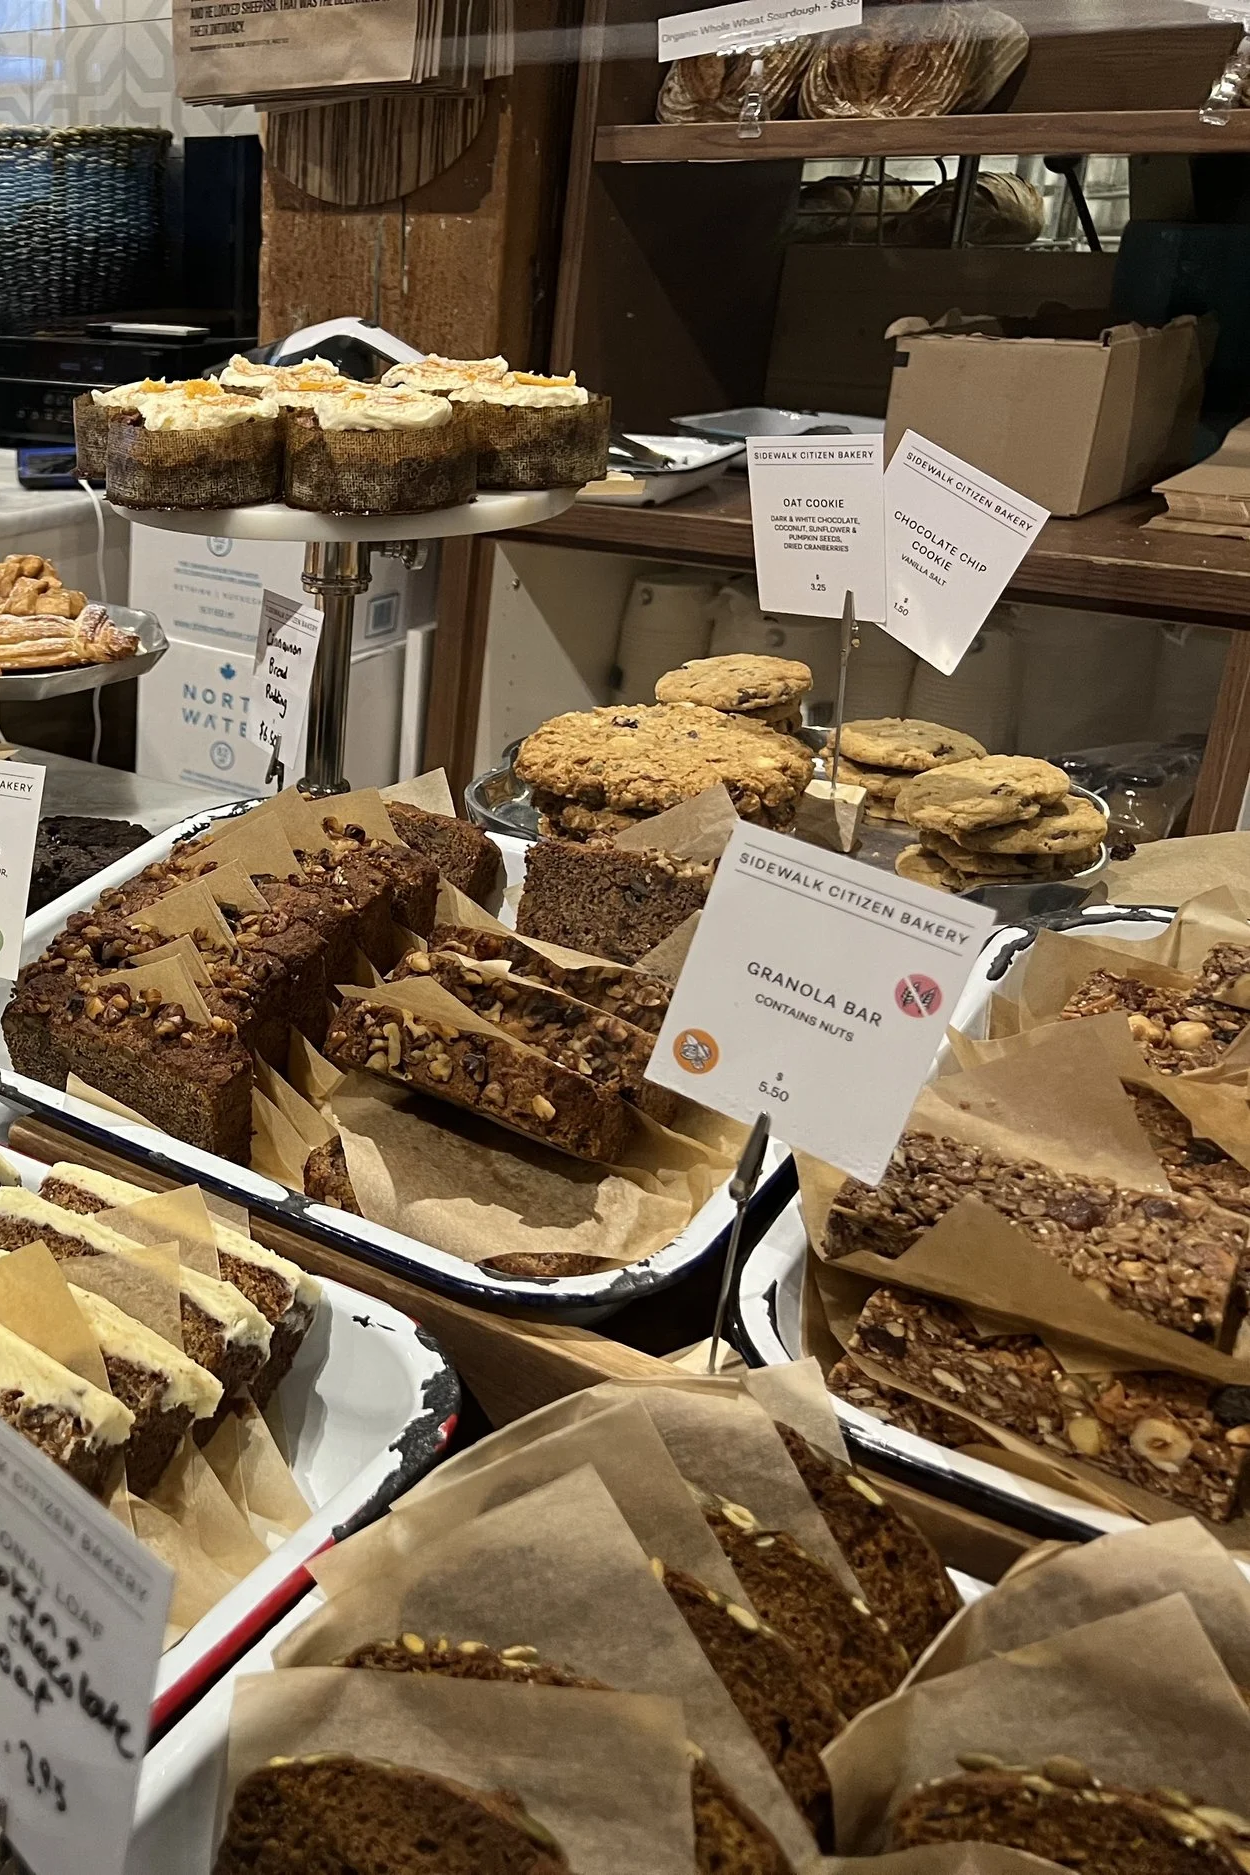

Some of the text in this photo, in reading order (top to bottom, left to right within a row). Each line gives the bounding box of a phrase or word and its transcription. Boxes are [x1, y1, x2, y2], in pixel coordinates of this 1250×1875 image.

[700, 22, 730, 34] Whole
[733, 16, 764, 28] Wheat
[767, 4, 820, 21] Sourdough
[754, 450, 874, 460] SIDEWALK CITIZEN BAKERY
[783, 498, 845, 508] OAT COOKIE
[906, 452, 1033, 532] SIDEWALK CITIZEN BAKERY
[774, 524, 808, 533] COCONUT,
[809, 525, 850, 534] SUNFLOWER
[817, 516, 860, 525] CHOCOLATE,
[784, 542, 849, 552] DRIED CRANBERRIES
[789, 533, 843, 543] PUMPKIN SEEDS,
[894, 510, 987, 573] CHOCOLATE CHIP
[911, 541, 953, 571] COOKIE
[901, 554, 947, 587] VANILLA SALT
[810, 583, 827, 591] 3.25
[893, 602, 909, 616] 1.50
[182, 683, 250, 711] NORT
[181, 707, 247, 738] WATE
[739, 852, 970, 946] SIDEWALK CITIZEN BAKERY
[747, 961, 883, 1027] GRANOLA BAR
[754, 993, 854, 1042] CONTAINS NUTS
[776, 1072, 783, 1081] $
[758, 1081, 790, 1102] 5.50
[56, 1581, 104, 1637] LOAF
